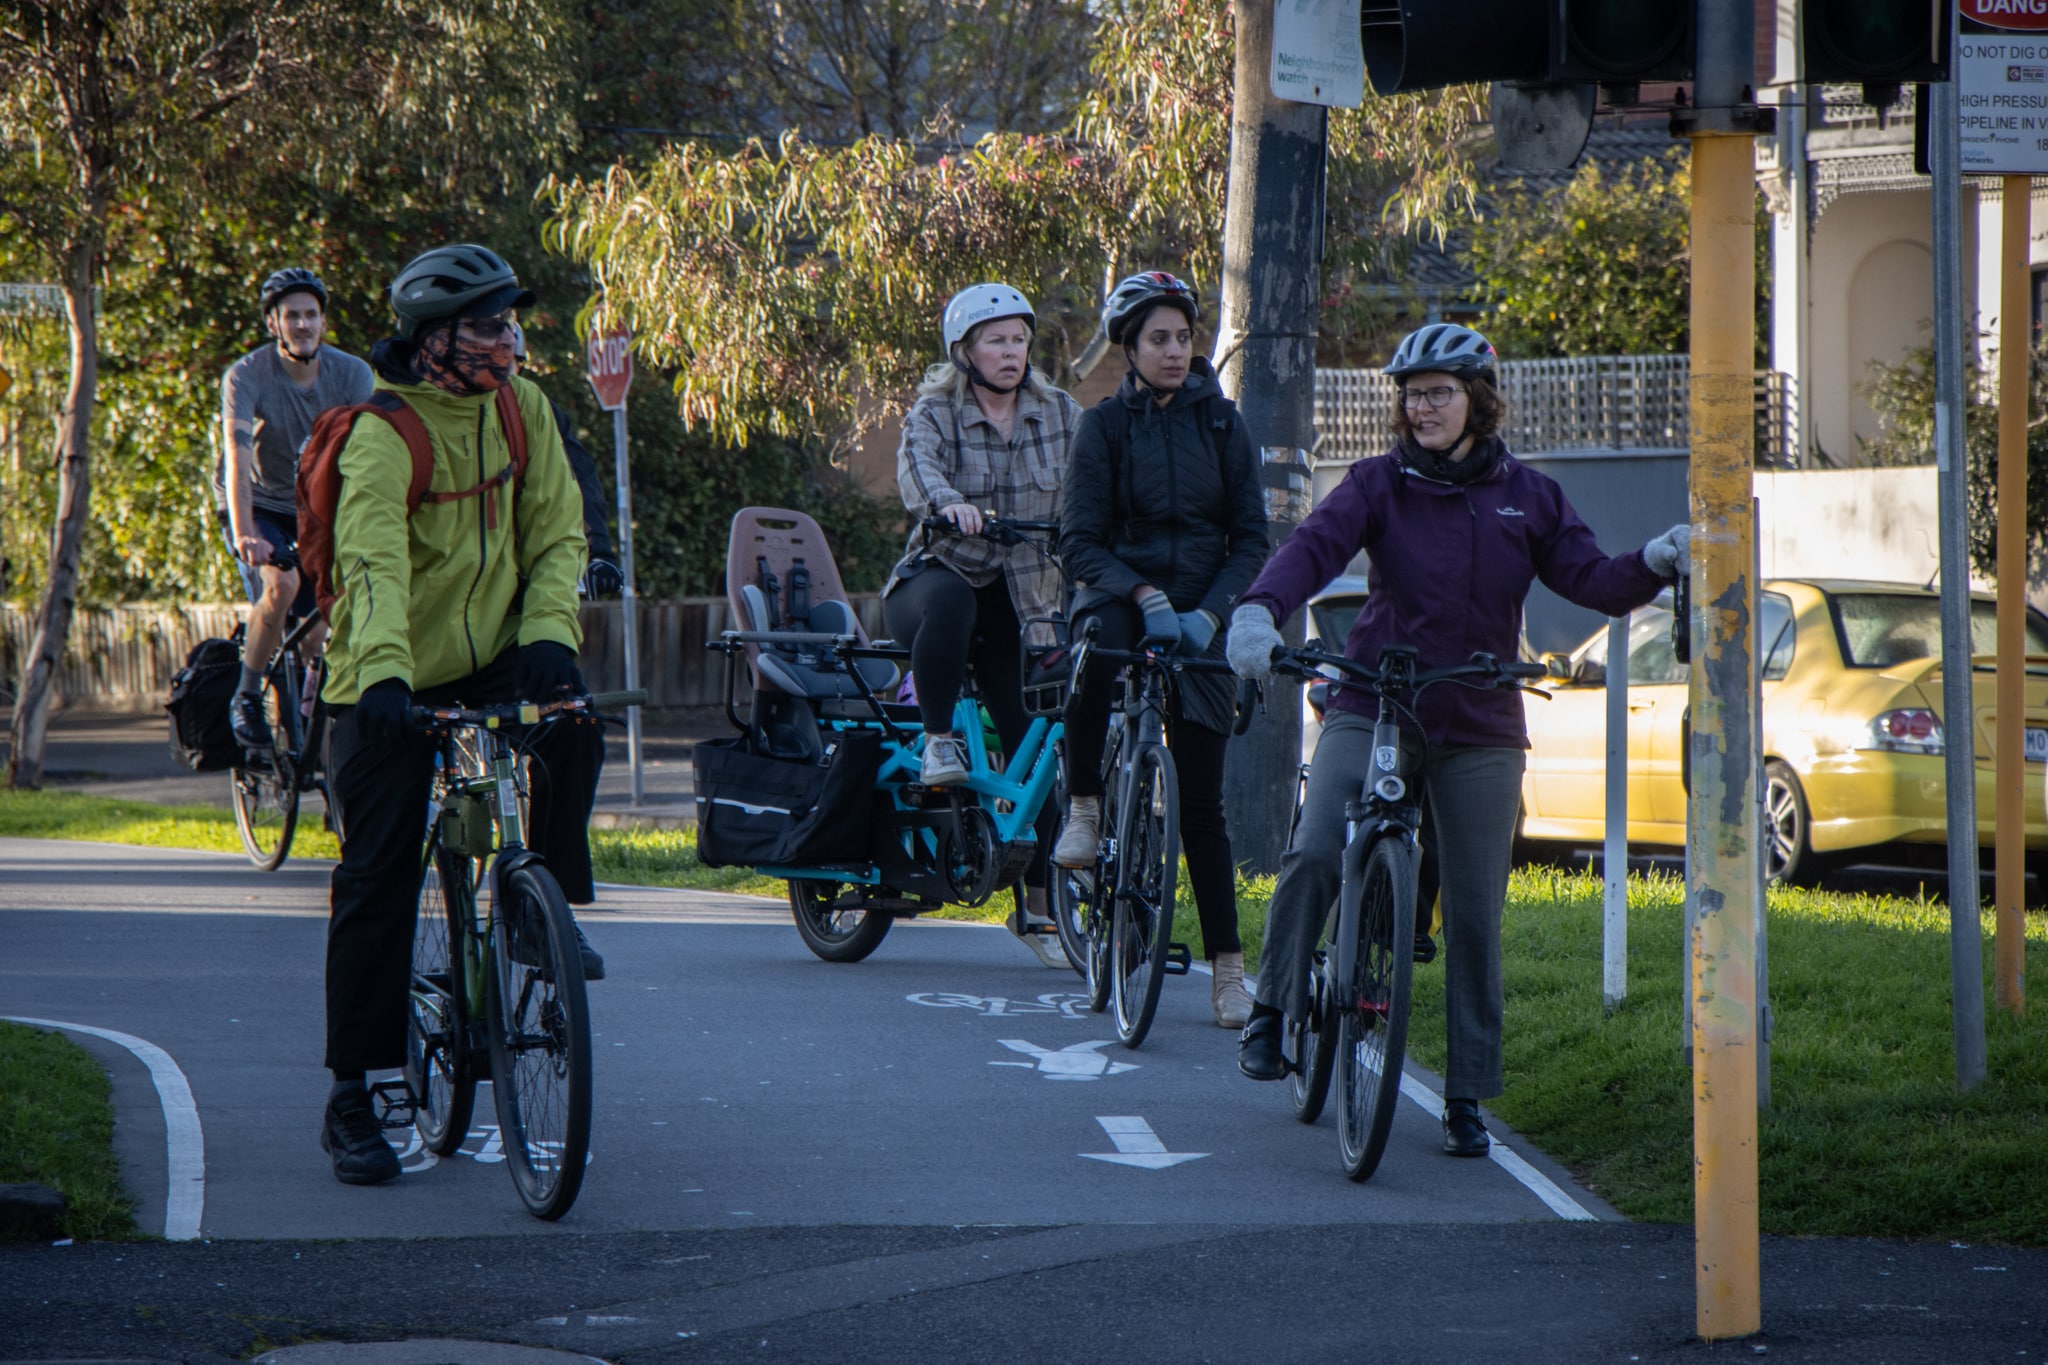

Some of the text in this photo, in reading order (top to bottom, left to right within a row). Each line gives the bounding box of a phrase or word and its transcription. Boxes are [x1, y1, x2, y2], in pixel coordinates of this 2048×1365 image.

[1959, 45, 1973, 59] O
[1977, 46, 2007, 59] NOT
[2010, 46, 2035, 59] DIG
[1993, 95, 2048, 109] PRESSU
[1960, 116, 2018, 130] PIPELINE
[2021, 117, 2035, 130] IN
[591, 336, 627, 376] STOP
